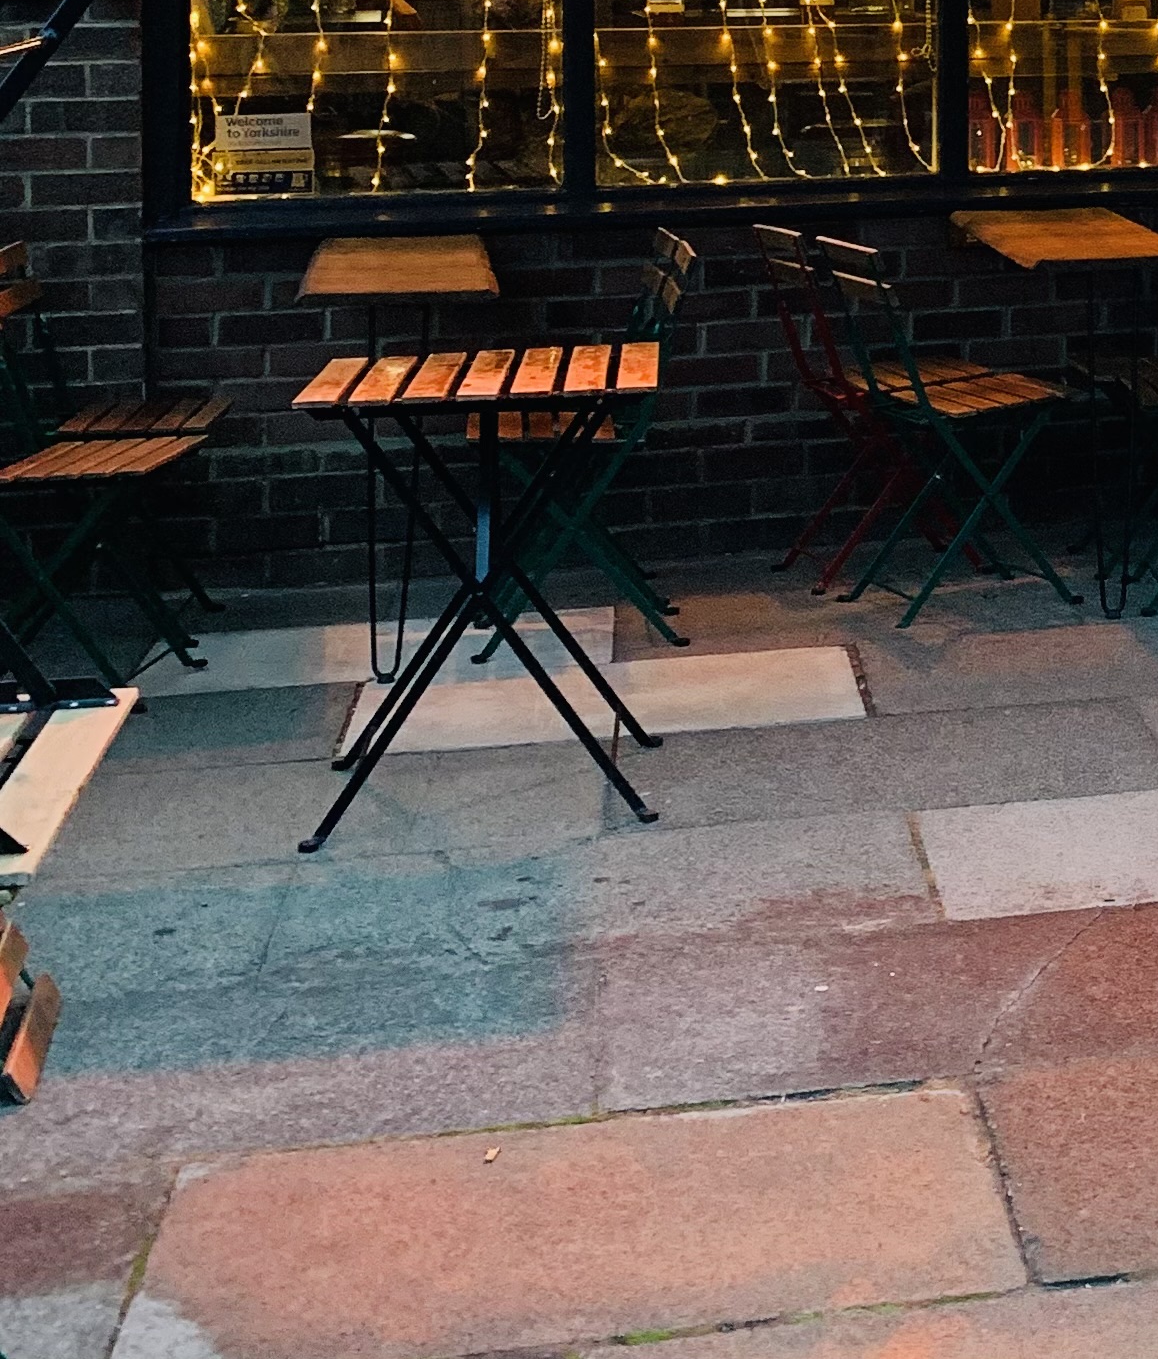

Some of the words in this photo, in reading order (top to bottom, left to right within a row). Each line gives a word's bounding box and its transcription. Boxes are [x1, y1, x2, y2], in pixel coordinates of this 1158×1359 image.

[225, 117, 283, 127] Welcome
[227, 129, 241, 138] to
[243, 127, 300, 138] Yorkshire
